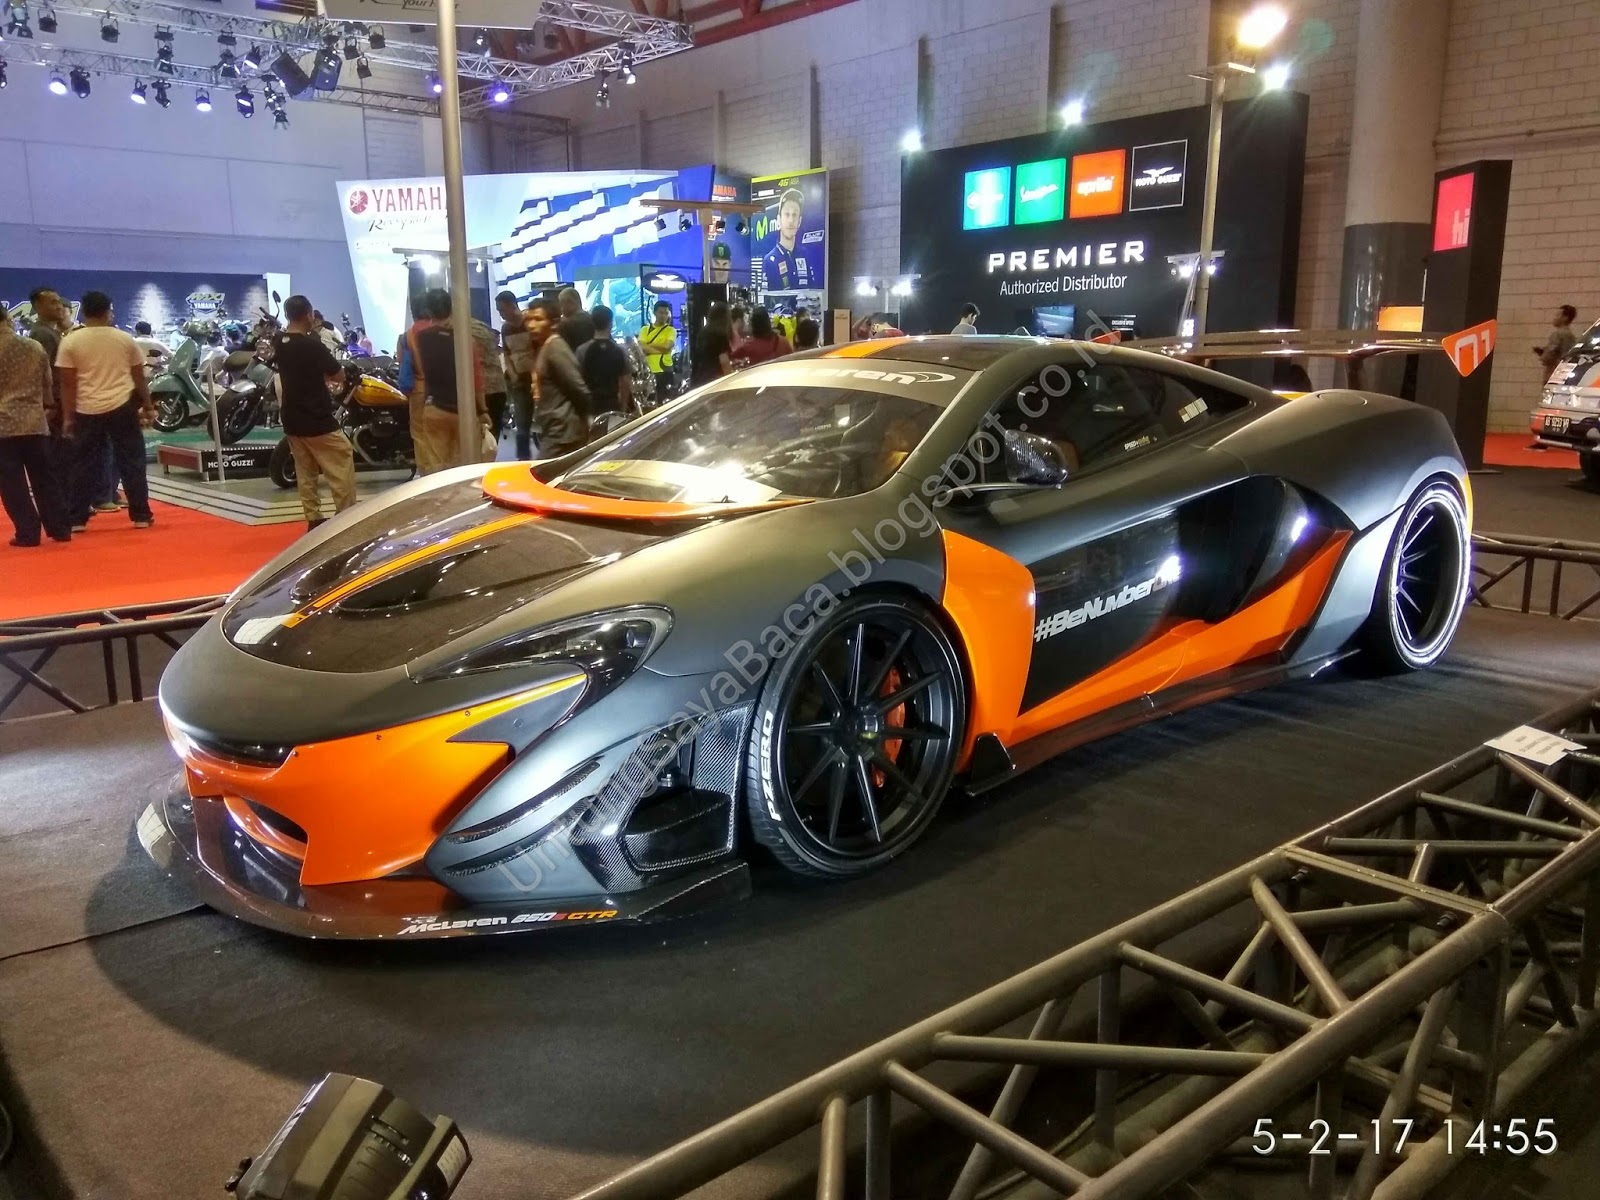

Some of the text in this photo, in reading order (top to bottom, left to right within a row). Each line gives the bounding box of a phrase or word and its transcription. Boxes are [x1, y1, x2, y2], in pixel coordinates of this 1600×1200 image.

[371, 186, 447, 212] YAMAH
[989, 240, 1145, 273] PREMIER
[1000, 273, 1127, 296] Authorized Distributor
[231, 459, 253, 467] GUZZI
[1034, 560, 1181, 643] #BeNumberO
[397, 916, 507, 936] McLaren
